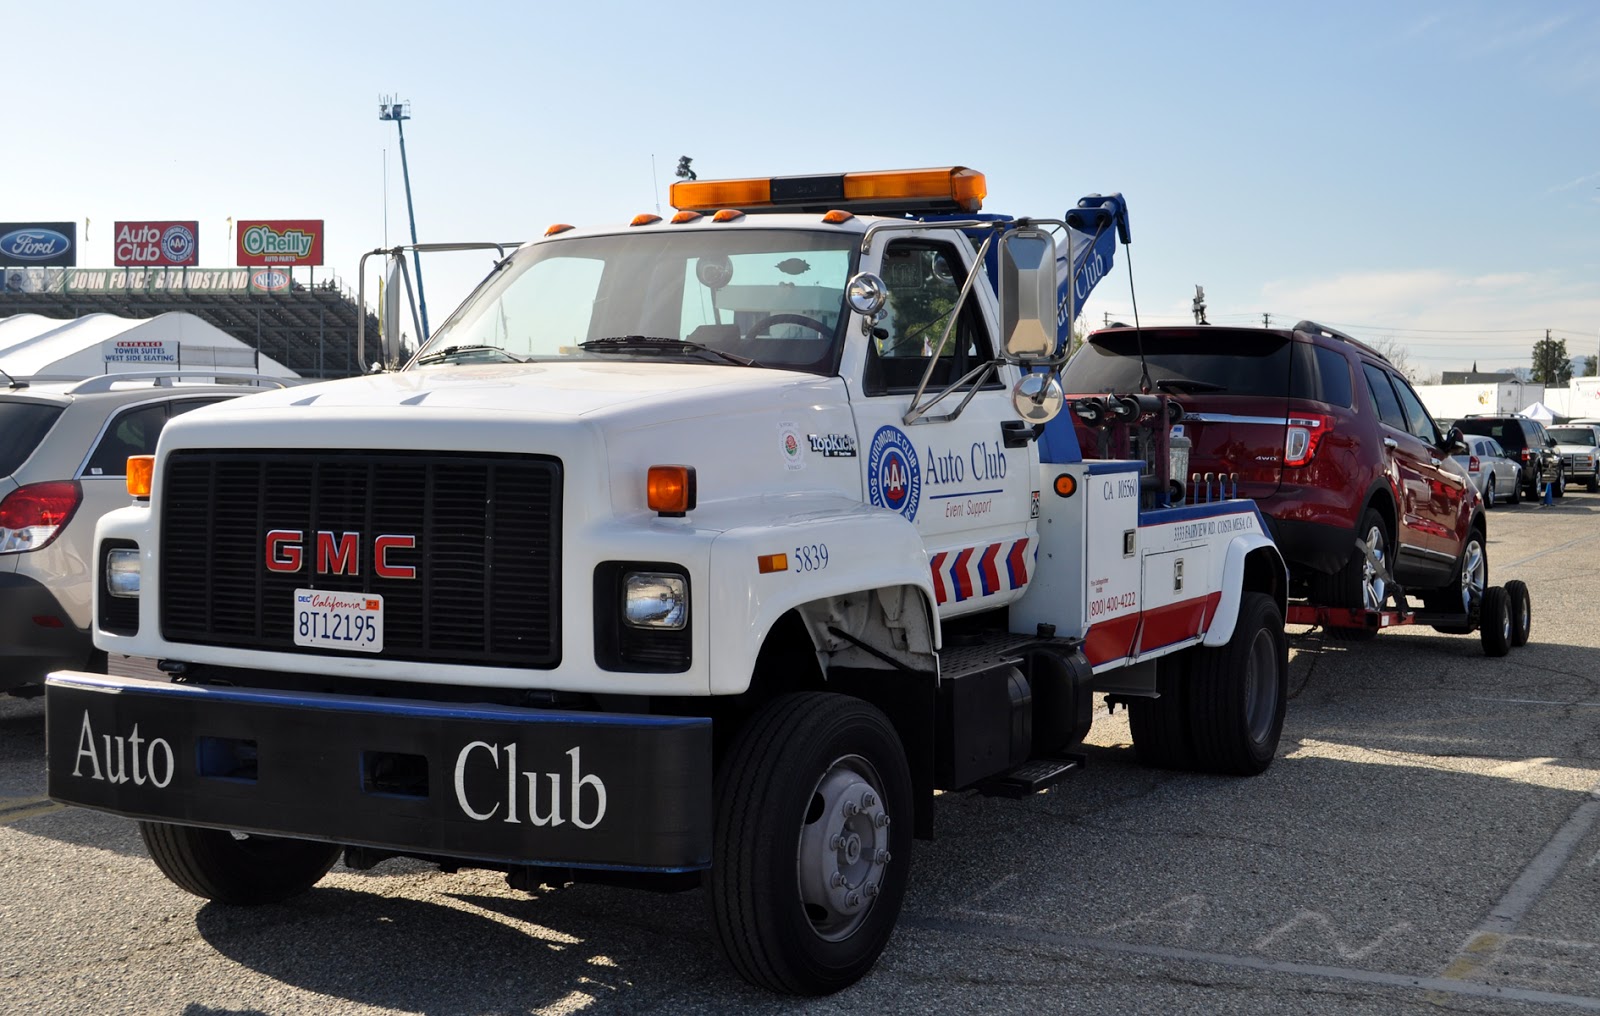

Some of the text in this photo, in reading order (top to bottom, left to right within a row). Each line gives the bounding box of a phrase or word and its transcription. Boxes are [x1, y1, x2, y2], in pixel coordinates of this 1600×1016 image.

[12, 233, 56, 254] Ford
[116, 225, 160, 243] Auto
[170, 238, 185, 249] AAA
[244, 227, 312, 256] O'Reilly
[117, 243, 160, 262] Club
[69, 271, 250, 289] JOHN FORCE GRANDSTAND
[256, 271, 286, 288] NHRA
[1075, 248, 1104, 300] Club
[871, 430, 917, 471] AUTOMOBILE CLUB
[925, 441, 1007, 485] Auto Club
[883, 463, 907, 492] AAA
[1103, 481, 1114, 500] CA
[945, 499, 992, 518] Event Support
[265, 529, 416, 579] GMC
[794, 543, 829, 573] 5839
[298, 595, 310, 603] DEC
[312, 594, 366, 612] California
[1089, 591, 1136, 619] (800) 400-4222
[299, 611, 376, 643] 8T12195
[72, 709, 608, 830] Auto Club
